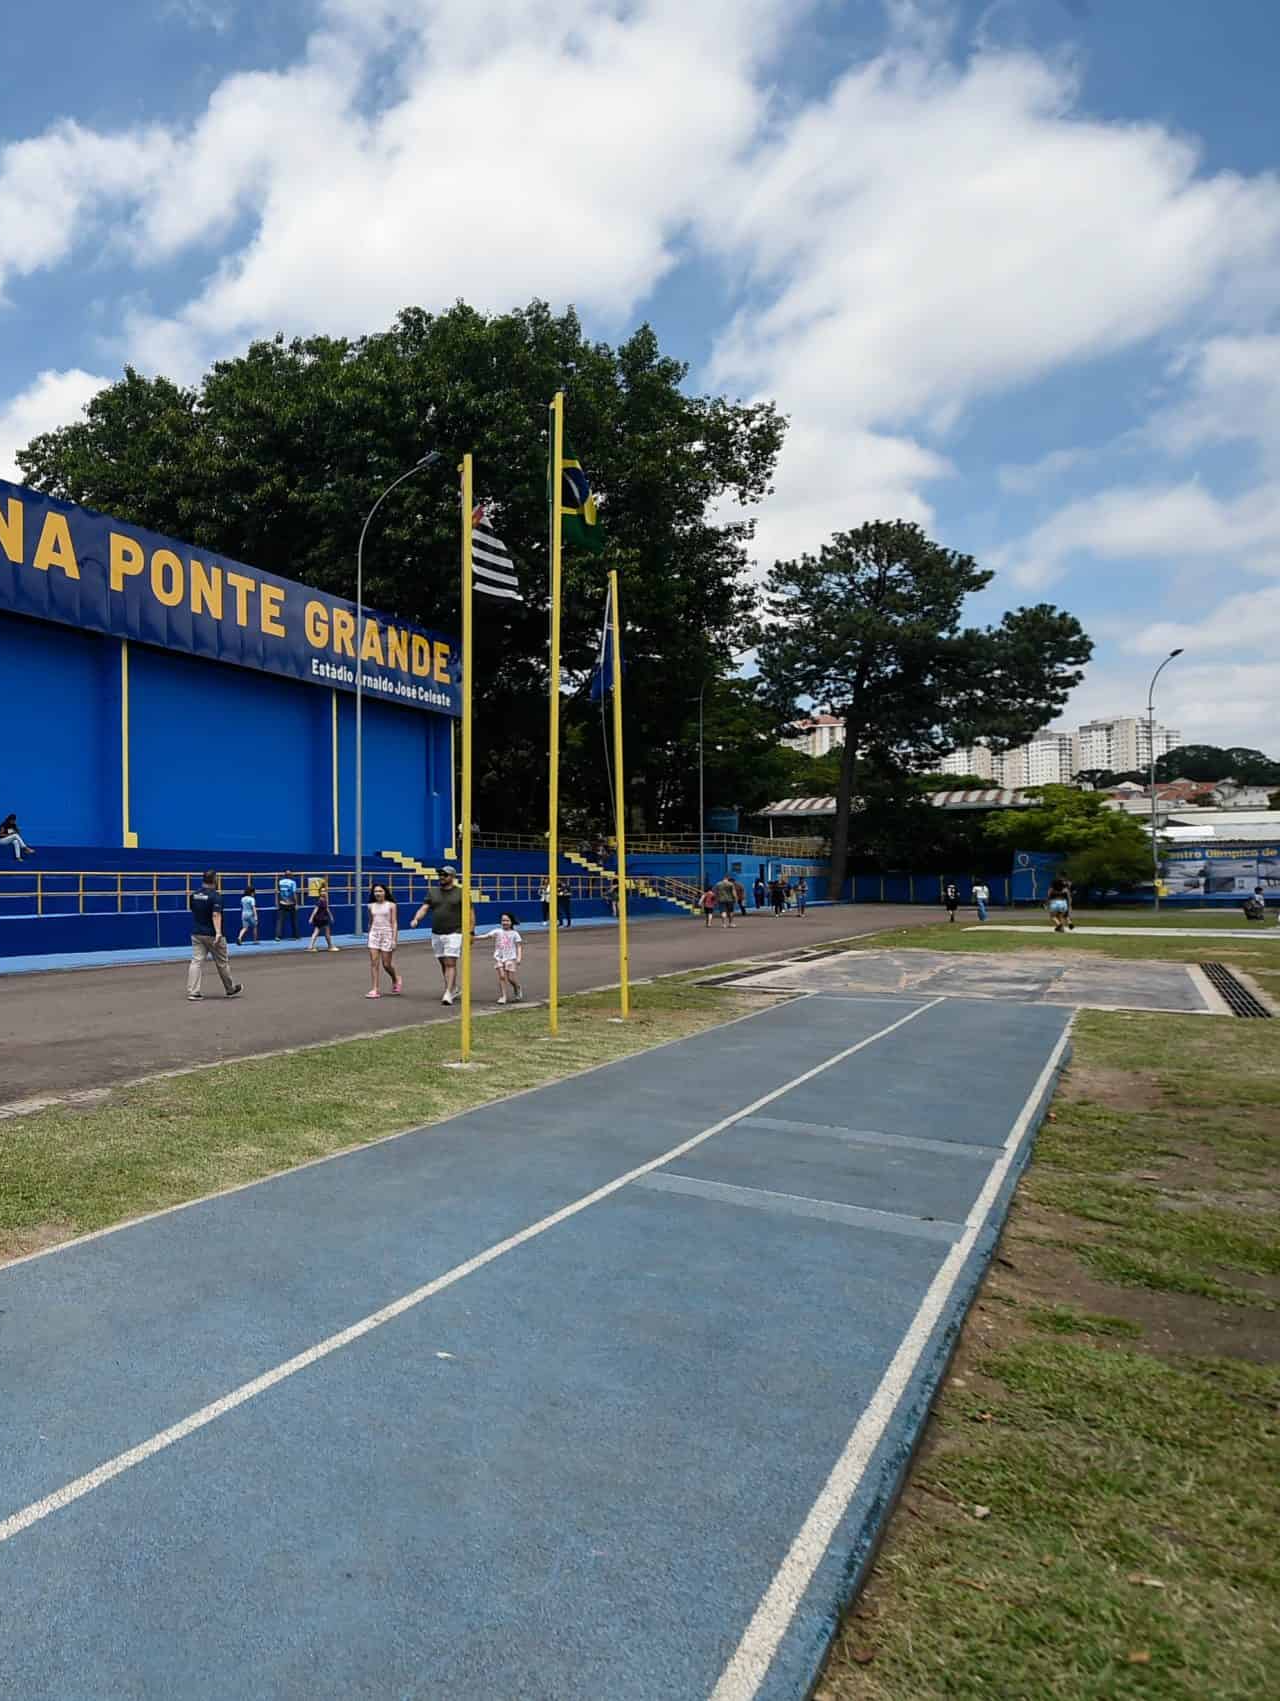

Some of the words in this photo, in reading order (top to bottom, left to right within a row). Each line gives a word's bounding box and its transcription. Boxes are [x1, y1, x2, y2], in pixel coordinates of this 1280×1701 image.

[110, 532, 286, 638] PONTE
[304, 600, 451, 685] GRANDE
[311, 658, 353, 683] Estádio
[395, 680, 417, 700] José
[418, 686, 451, 707] Celeste
